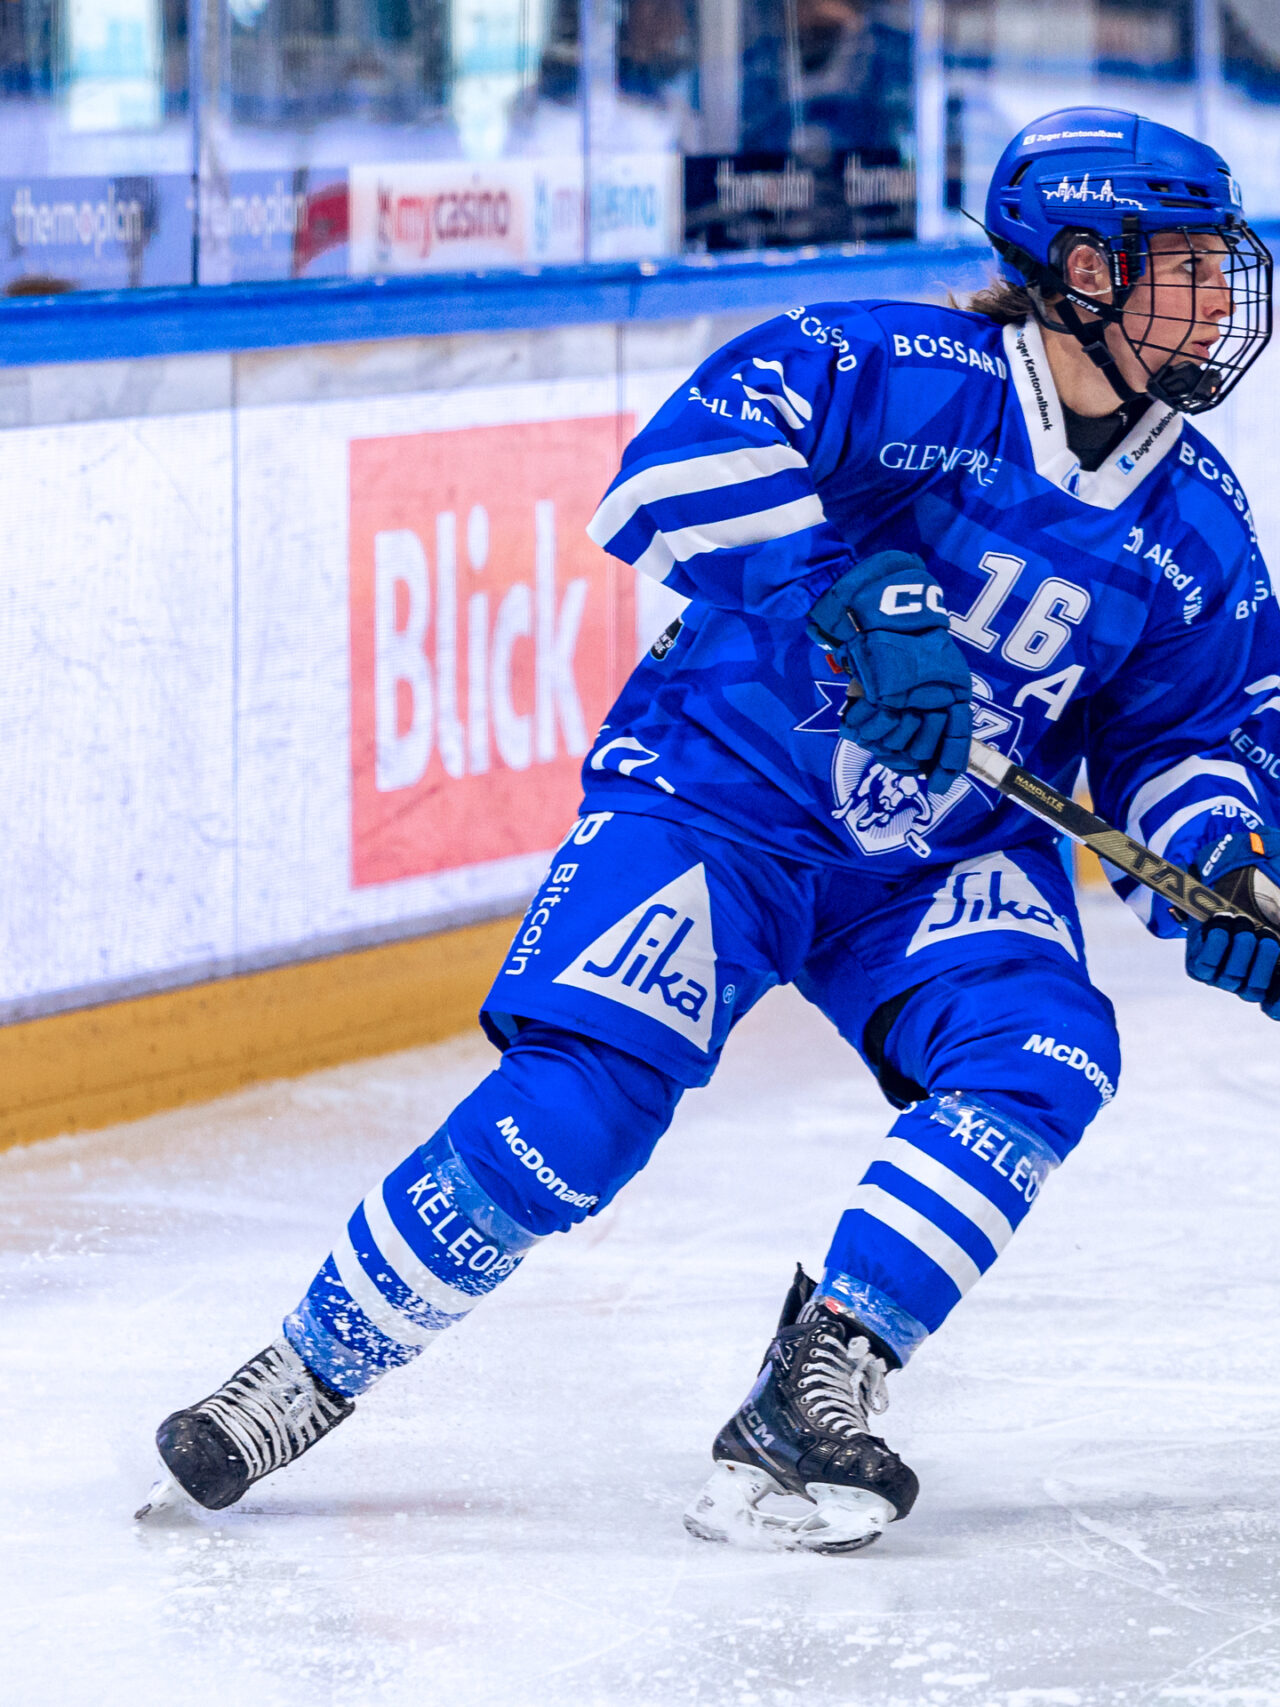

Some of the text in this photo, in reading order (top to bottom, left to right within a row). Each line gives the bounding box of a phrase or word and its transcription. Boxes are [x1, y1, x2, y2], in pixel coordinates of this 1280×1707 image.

[1066, 293, 1099, 312] CCM
[893, 334, 1007, 380] BOSSARD
[1023, 358, 1053, 432] Kantonalbank
[1130, 434, 1154, 462] Zuger
[879, 583, 948, 616] CC
[947, 551, 1092, 672] 16
[374, 499, 590, 793] Blick
[1012, 663, 1086, 722] A
[1126, 840, 1229, 916] TAC
[1202, 833, 1233, 877] CCM
[505, 863, 580, 976] Bitcoin
[928, 870, 1060, 933] Sika
[583, 904, 708, 1022] Sika
[950, 1108, 1041, 1204] KELEO
